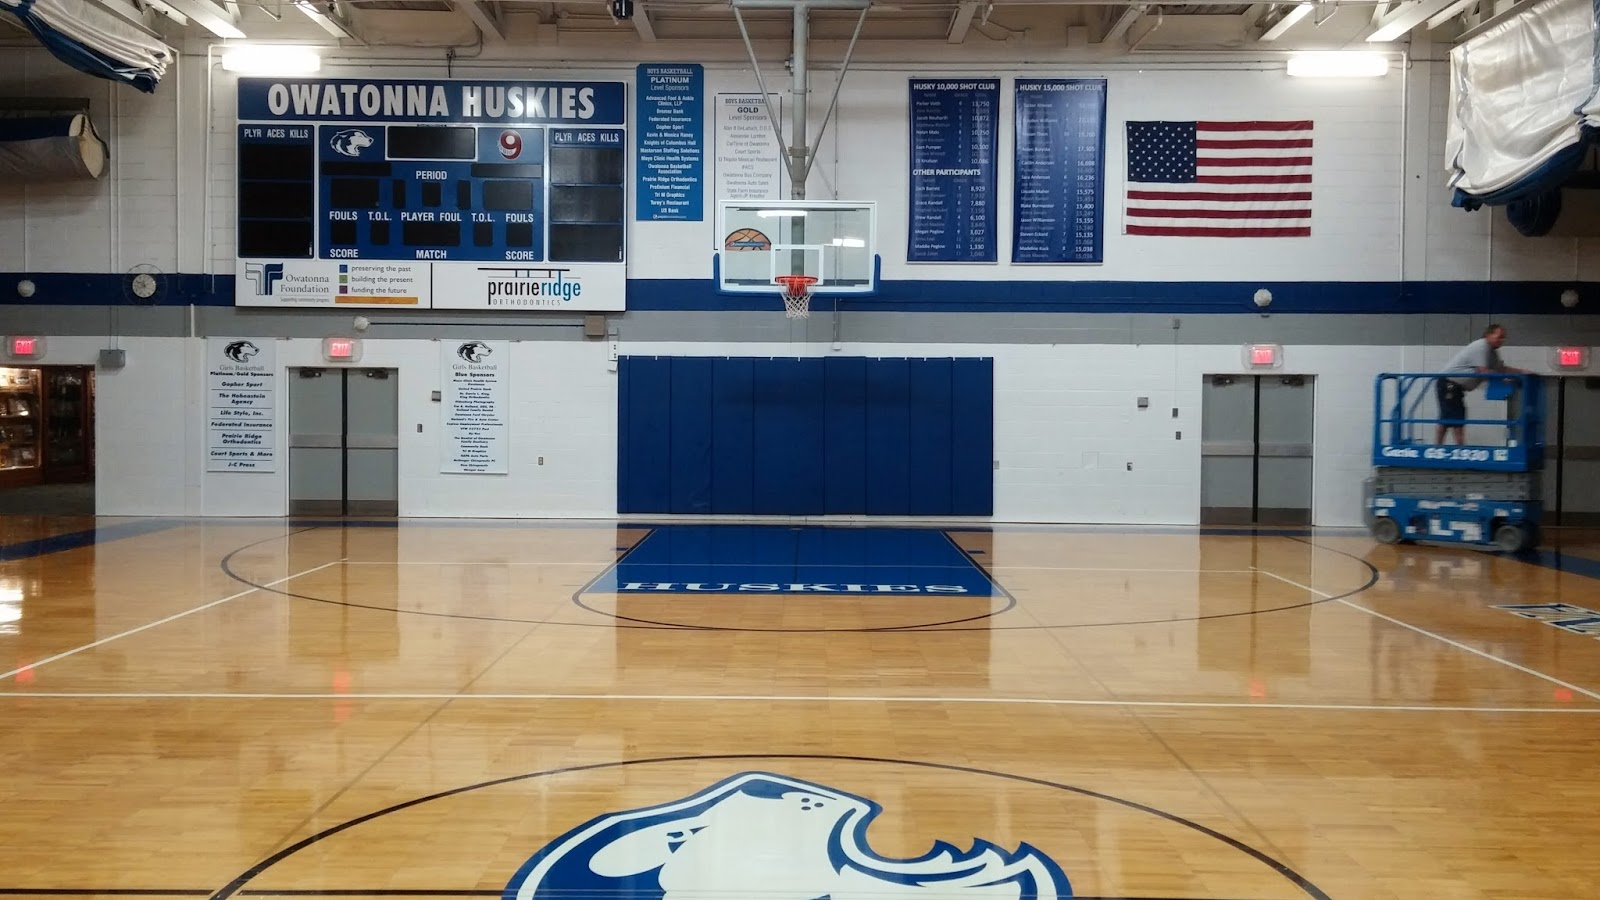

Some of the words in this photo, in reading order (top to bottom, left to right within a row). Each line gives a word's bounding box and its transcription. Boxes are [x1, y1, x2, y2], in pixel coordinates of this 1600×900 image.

[268, 83, 449, 117] OWATONNA
[463, 85, 595, 119] HUSKIES
[244, 128, 262, 138] PLYR
[266, 128, 285, 138] ACES
[290, 128, 308, 138] KILLS
[555, 132, 572, 142] PLYR
[577, 132, 595, 142] ACES
[600, 132, 619, 142] KILLS
[416, 170, 448, 180] PERIOD
[329, 211, 358, 222] FOULS
[368, 211, 392, 222] T.O.L.
[401, 211, 434, 222] PLAYER
[440, 211, 462, 222] FOUL
[471, 211, 495, 222] T.O.L.
[505, 211, 534, 224] FOULS
[330, 248, 358, 258] SCORE
[416, 248, 447, 260] MATCH
[505, 248, 534, 260] SCORE
[286, 274, 330, 282] Owatonna
[280, 284, 330, 293] Foundation
[619, 582, 968, 592] HUSKIES
